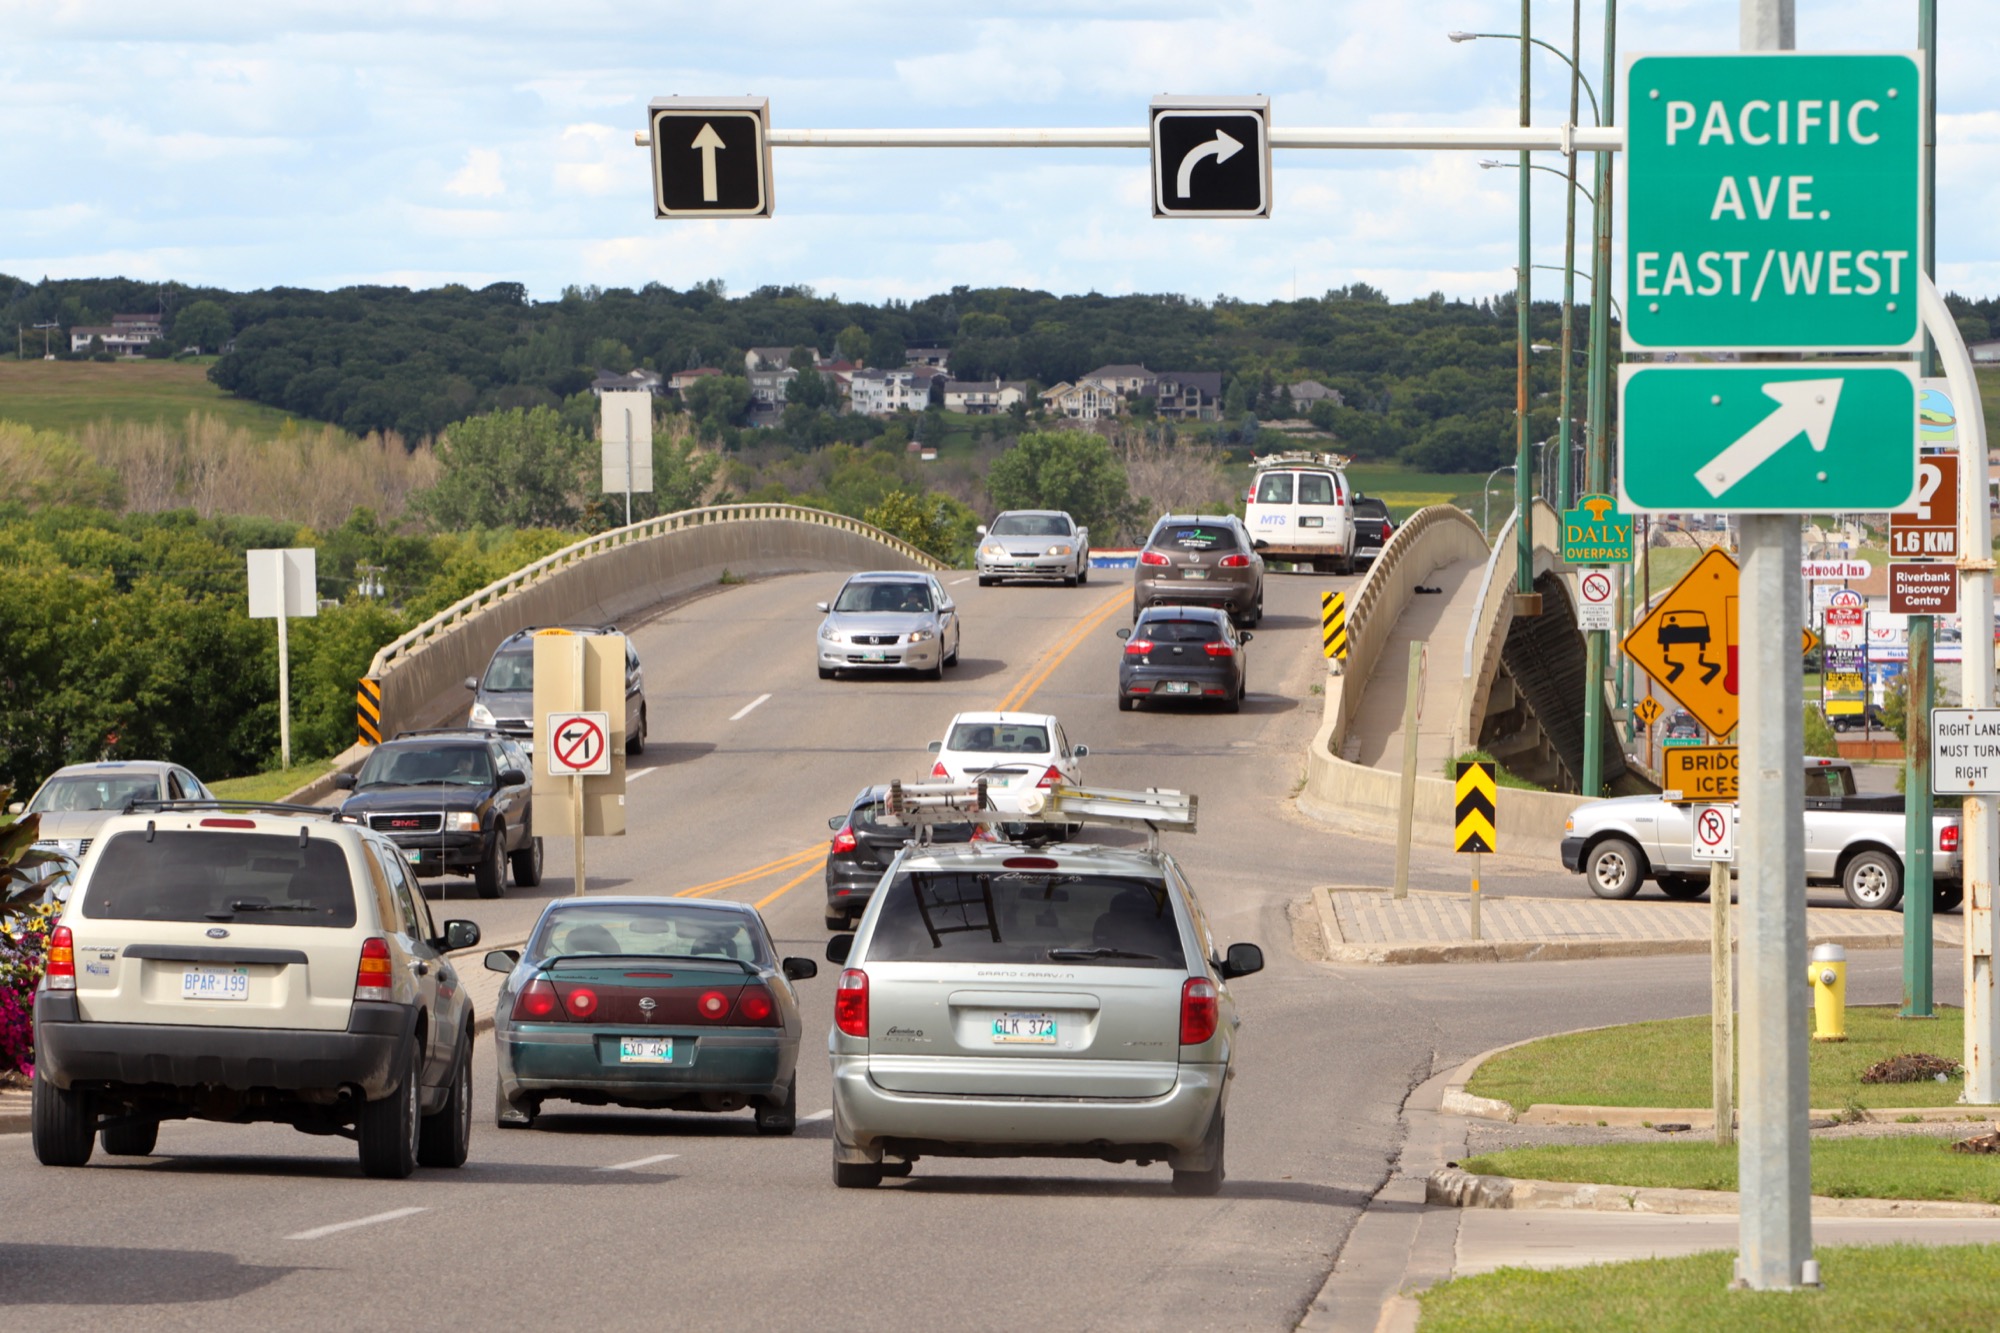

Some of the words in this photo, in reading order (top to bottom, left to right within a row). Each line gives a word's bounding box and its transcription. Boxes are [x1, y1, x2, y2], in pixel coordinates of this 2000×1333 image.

[1666, 100, 1880, 146] PACIFIC
[1710, 176, 1830, 220] AVE.
[1636, 250, 1908, 302] EAST/WEST
[1260, 515, 1286, 525] MTS
[1567, 525, 1630, 543] DALY
[1893, 531, 1920, 552] 1.6
[1924, 531, 1954, 552] KM
[1567, 548, 1629, 559] OVERPASS
[1801, 563, 1843, 577] edwood
[1847, 563, 1865, 577] Inn
[1896, 572, 1951, 582] Riverbank
[1896, 584, 1950, 596] Discovery
[1905, 595, 1941, 606] Centre
[1939, 724, 1971, 736] RIGHT
[1940, 745, 1969, 757] MUST
[1955, 766, 1988, 779] RIGHT
[208, 929, 225, 938] Ford
[1020, 971, 1075, 979] CARAVAN
[184, 974, 215, 991] BPAR
[223, 974, 246, 992] 199
[995, 1018, 1020, 1035] GLK
[1028, 1019, 1054, 1035] 373
[623, 1043, 643, 1056] EXD
[650, 1043, 670, 1056] 461
